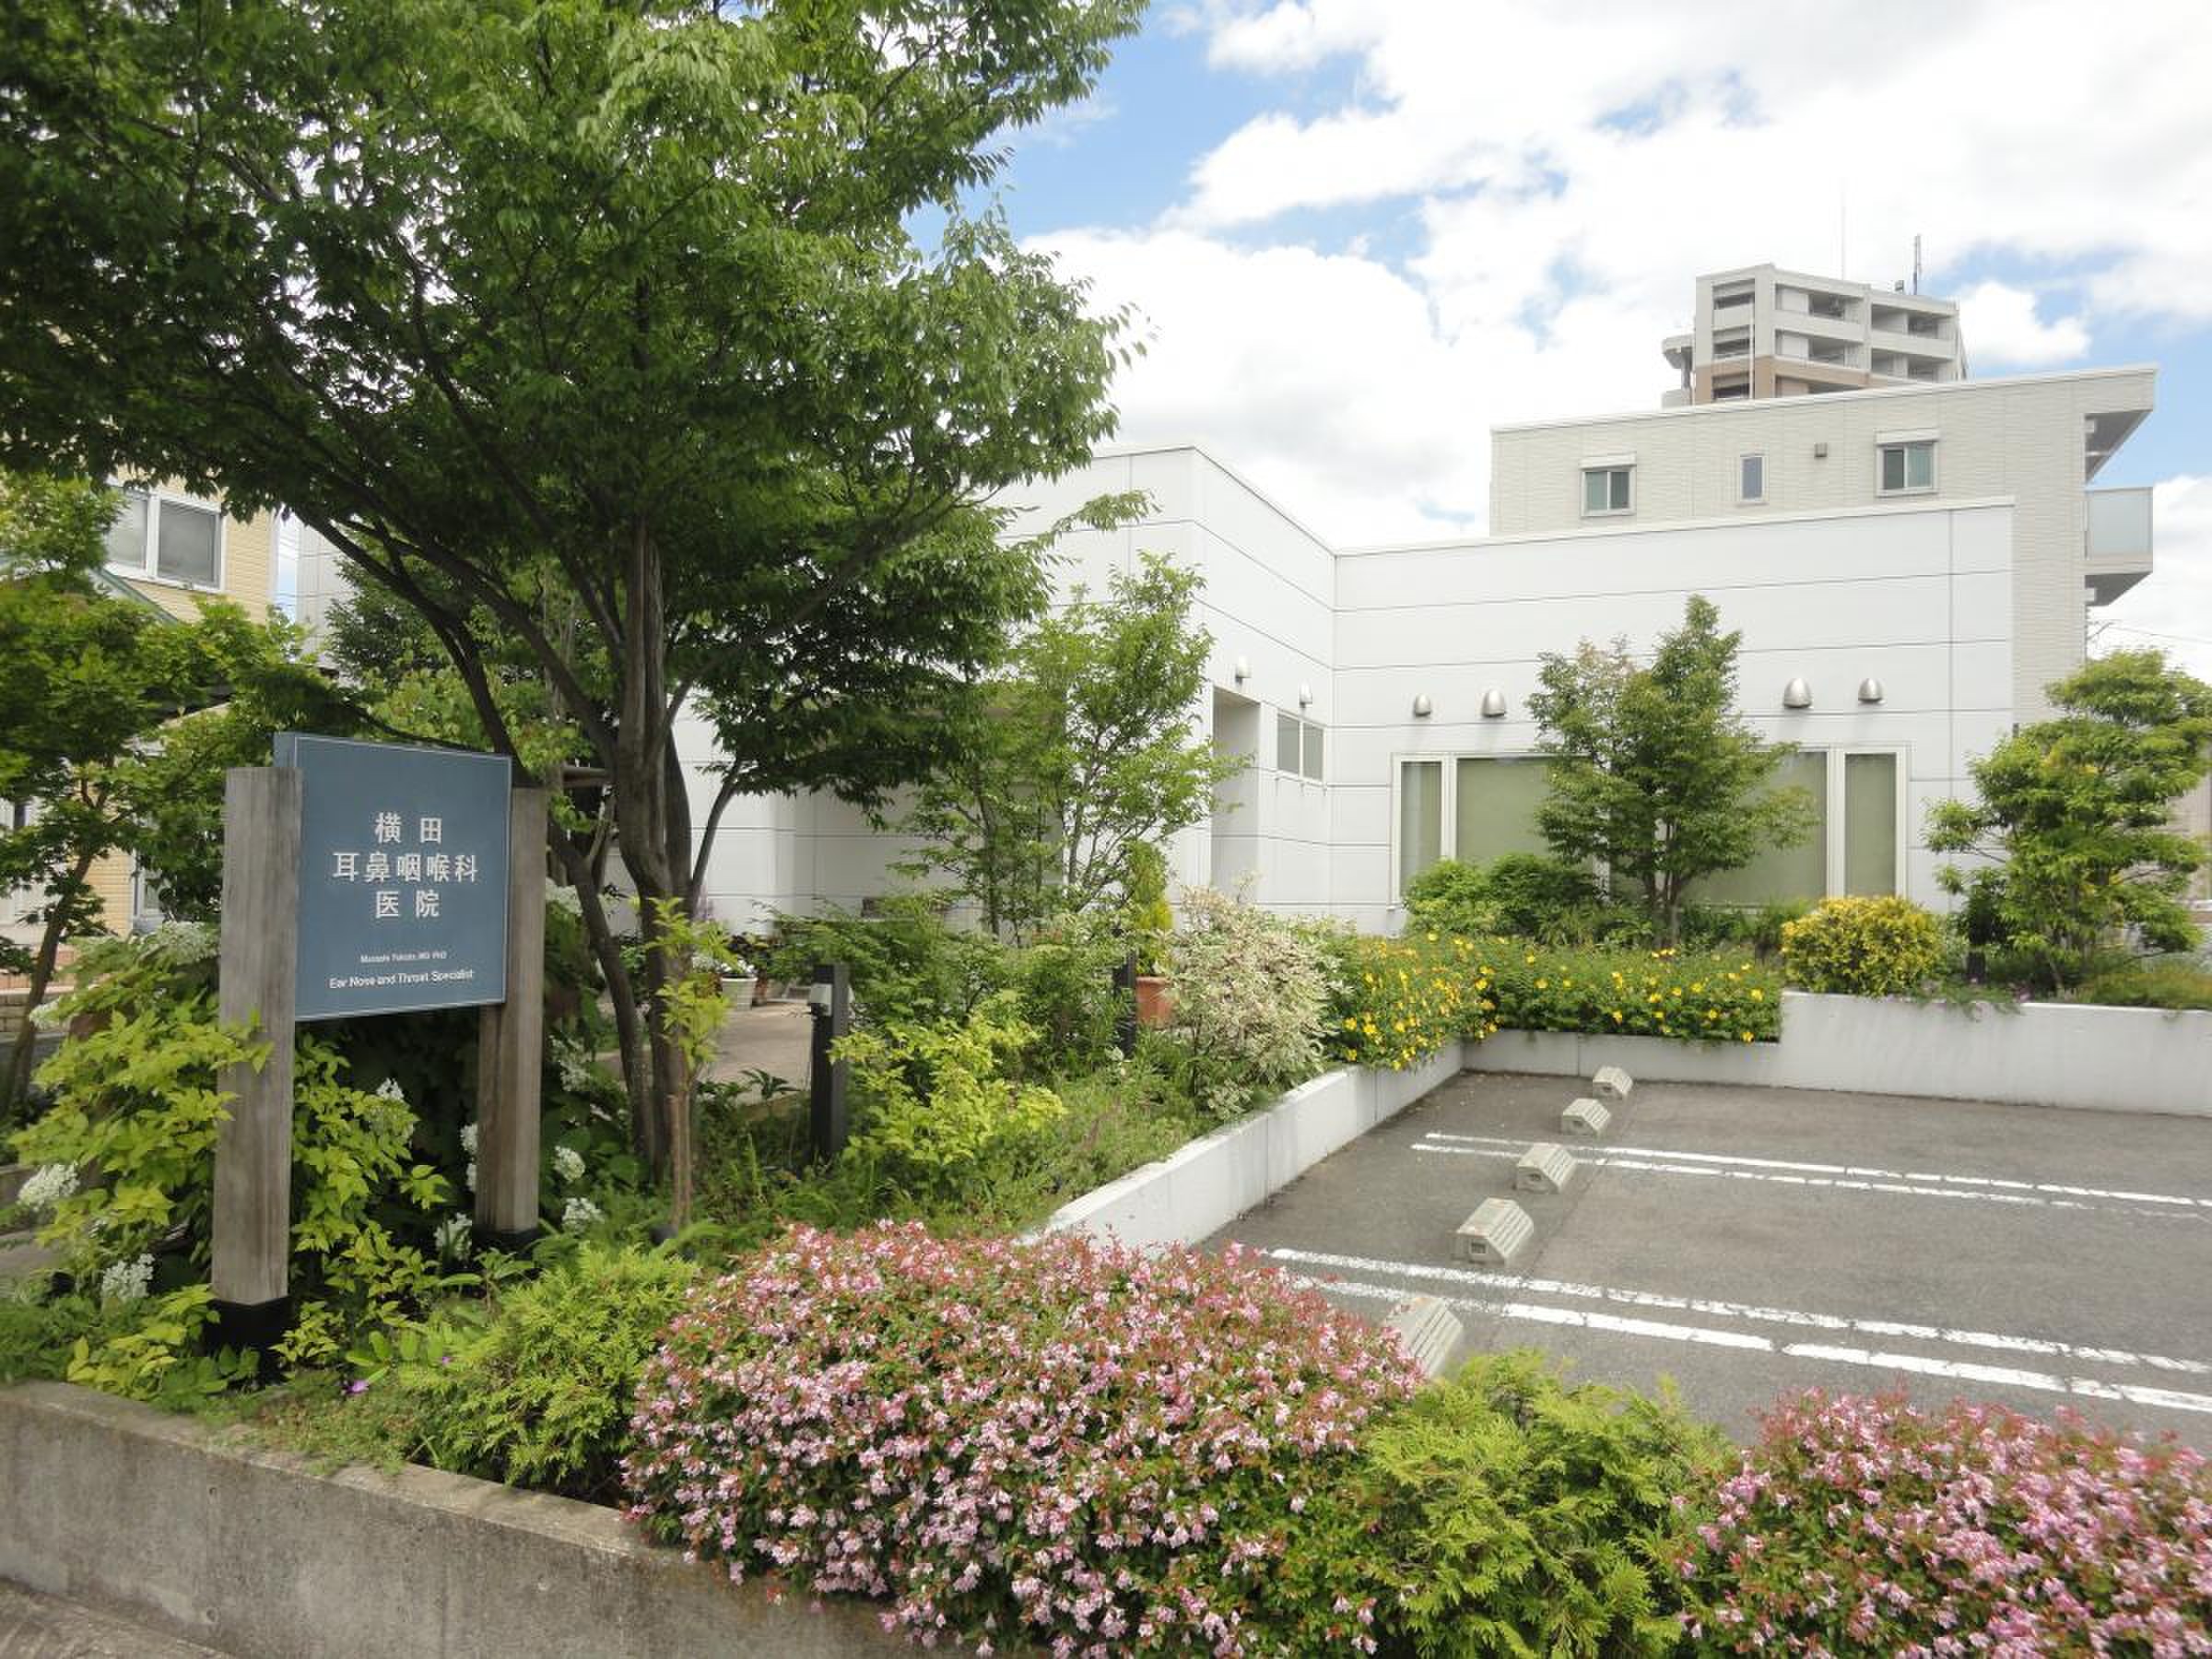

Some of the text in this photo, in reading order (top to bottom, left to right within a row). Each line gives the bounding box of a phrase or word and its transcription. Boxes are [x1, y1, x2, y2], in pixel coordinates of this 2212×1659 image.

[375, 812, 442, 843] 横田
[332, 852, 478, 883] 耳鼻咽喉科
[374, 890, 441, 918] 医院
[329, 969, 474, 989] Ear Nose and Throat Specialist
